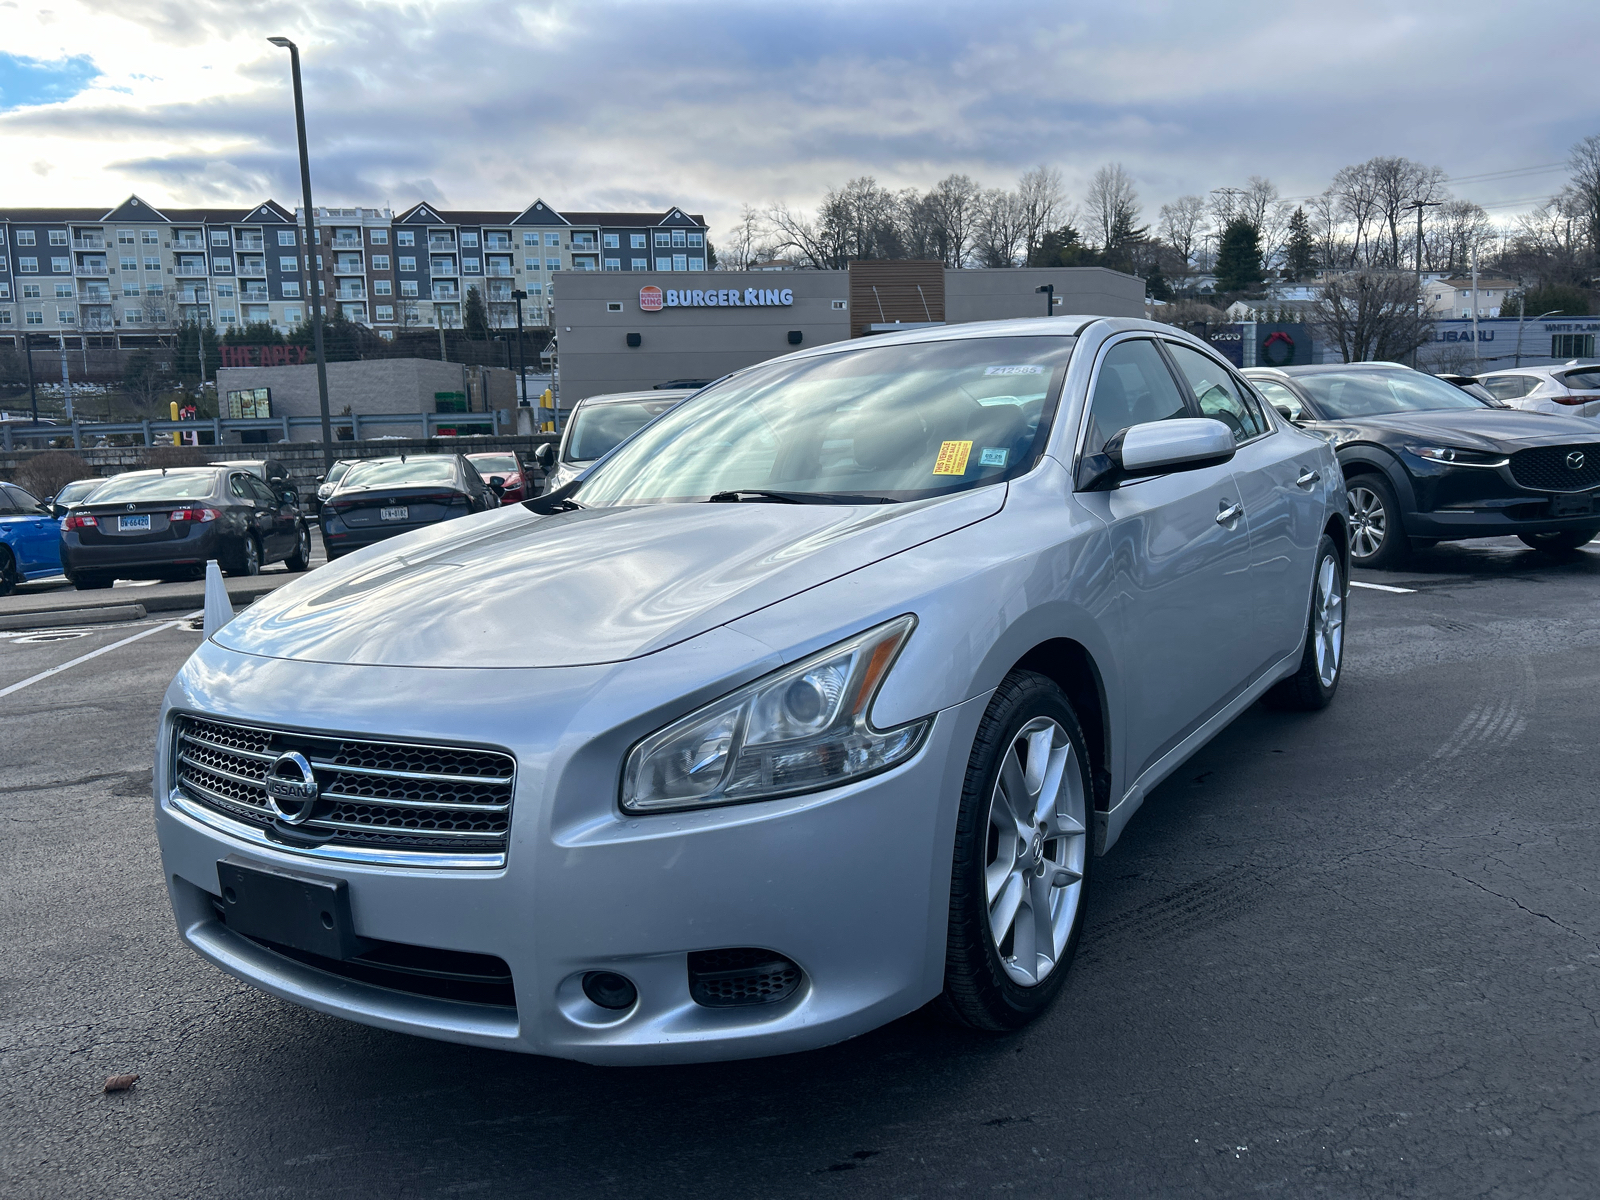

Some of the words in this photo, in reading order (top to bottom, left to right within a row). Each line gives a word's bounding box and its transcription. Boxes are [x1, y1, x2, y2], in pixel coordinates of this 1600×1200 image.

[667, 289, 740, 306] BURGER
[745, 288, 793, 305] KING
[1428, 331, 1495, 342] UBARU
[218, 346, 254, 367] THE
[261, 345, 307, 366] APEX
[990, 367, 1037, 375] Z12585
[938, 442, 951, 462] VEHICLE
[934, 462, 944, 473] THIS
[943, 463, 951, 472] NOT
[269, 782, 308, 798] NISSAN
